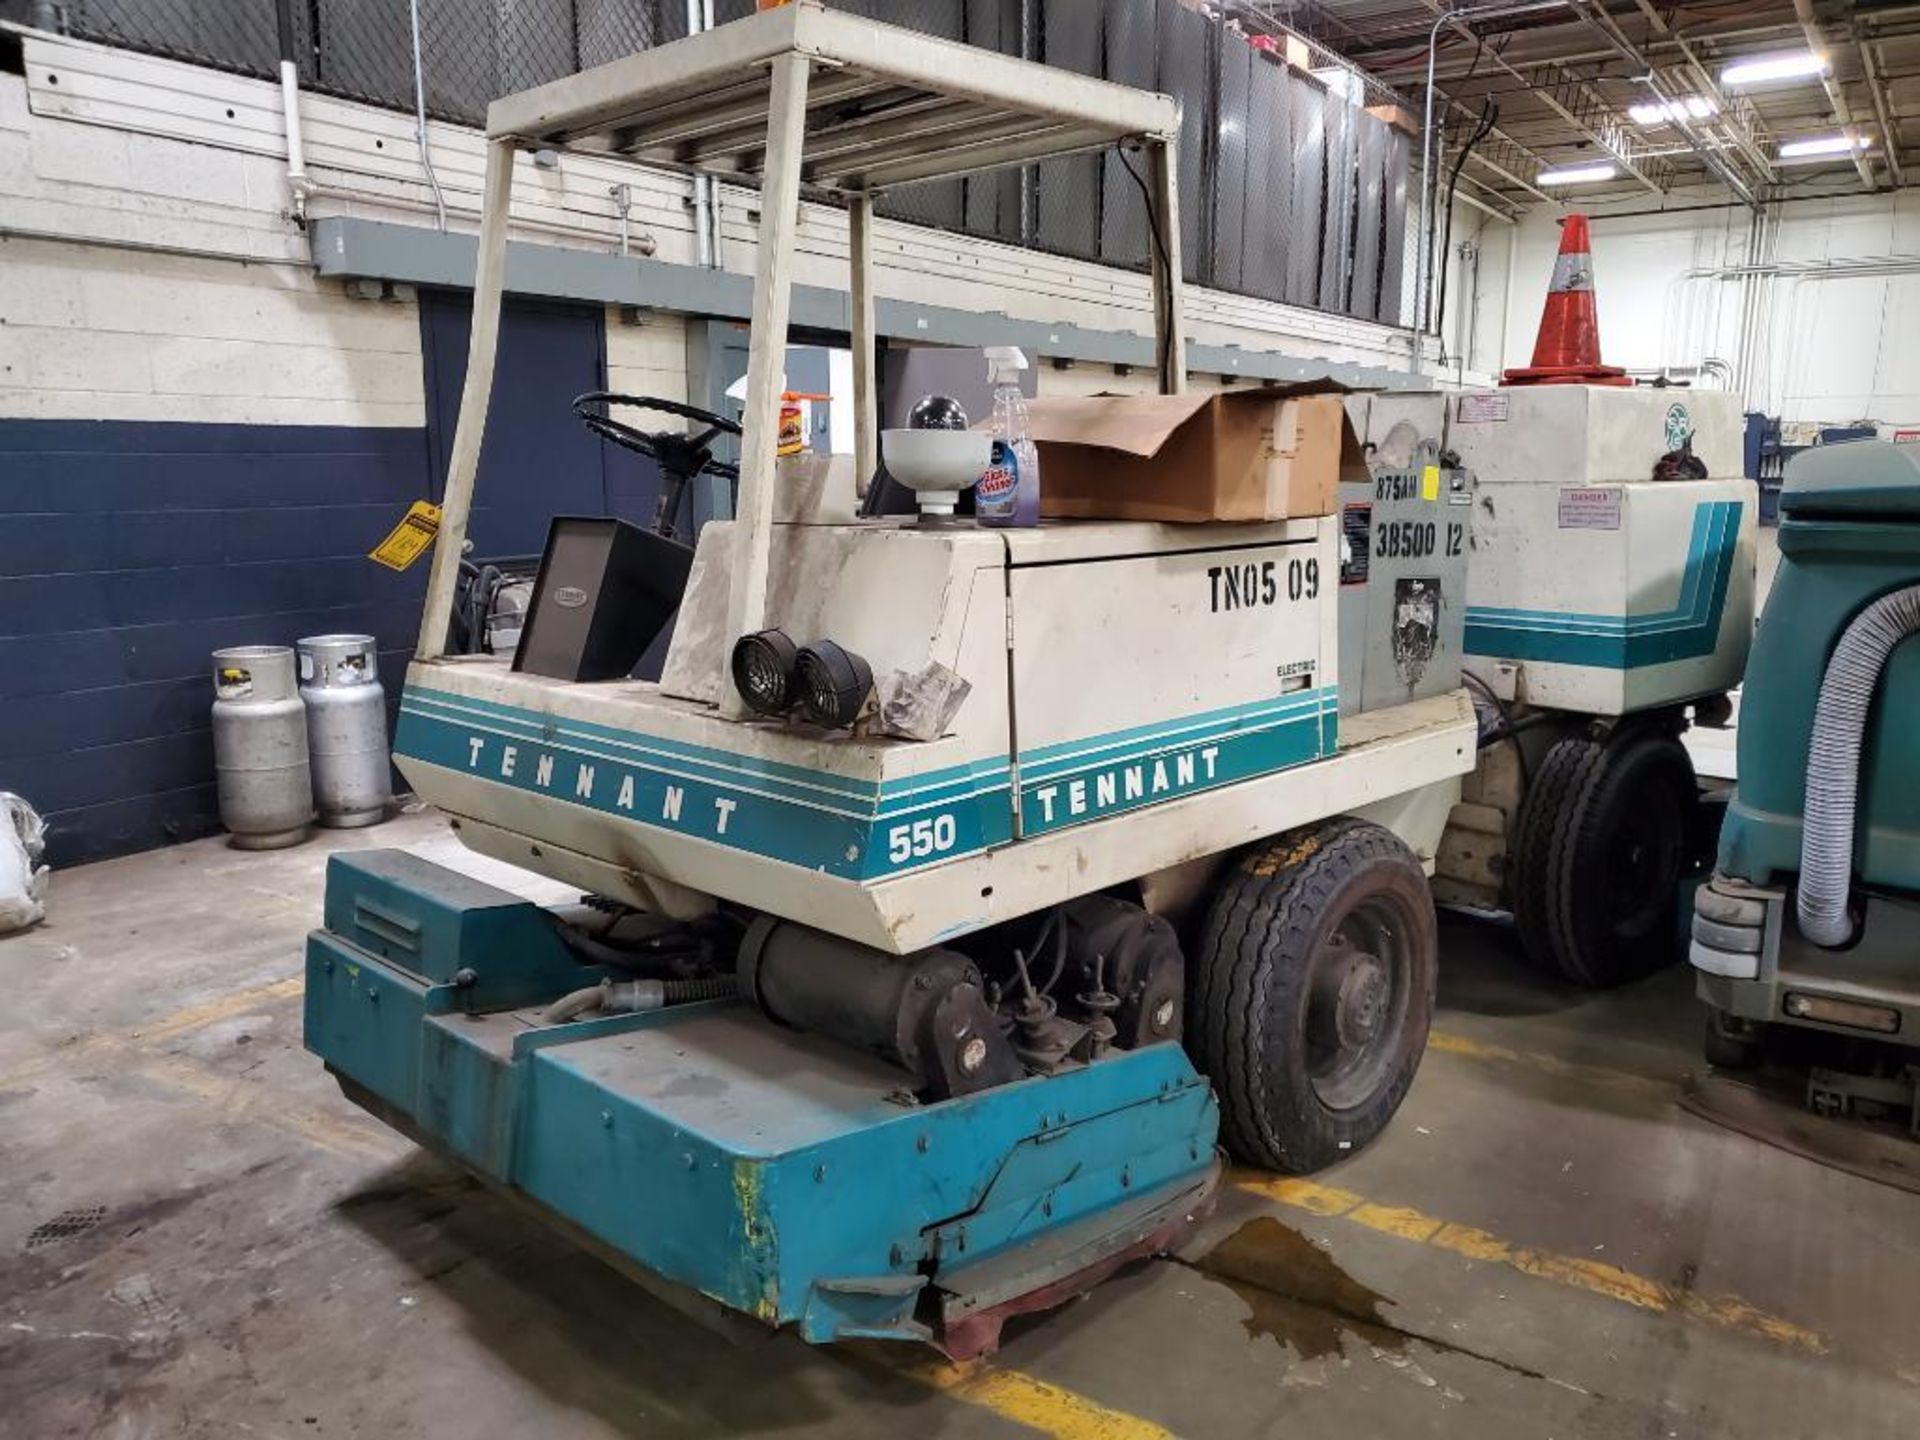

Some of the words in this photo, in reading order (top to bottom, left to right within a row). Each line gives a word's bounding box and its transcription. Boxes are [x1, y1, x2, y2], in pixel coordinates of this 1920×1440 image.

[1445, 521, 1463, 558] 12
[1207, 561, 1276, 613] TN05
[1288, 557, 1319, 602] 09
[1277, 659, 1315, 677] ELECTRIC
[469, 737, 737, 834] TENNANT
[1037, 747, 1219, 823] TENNANT
[889, 814, 956, 864] 550
